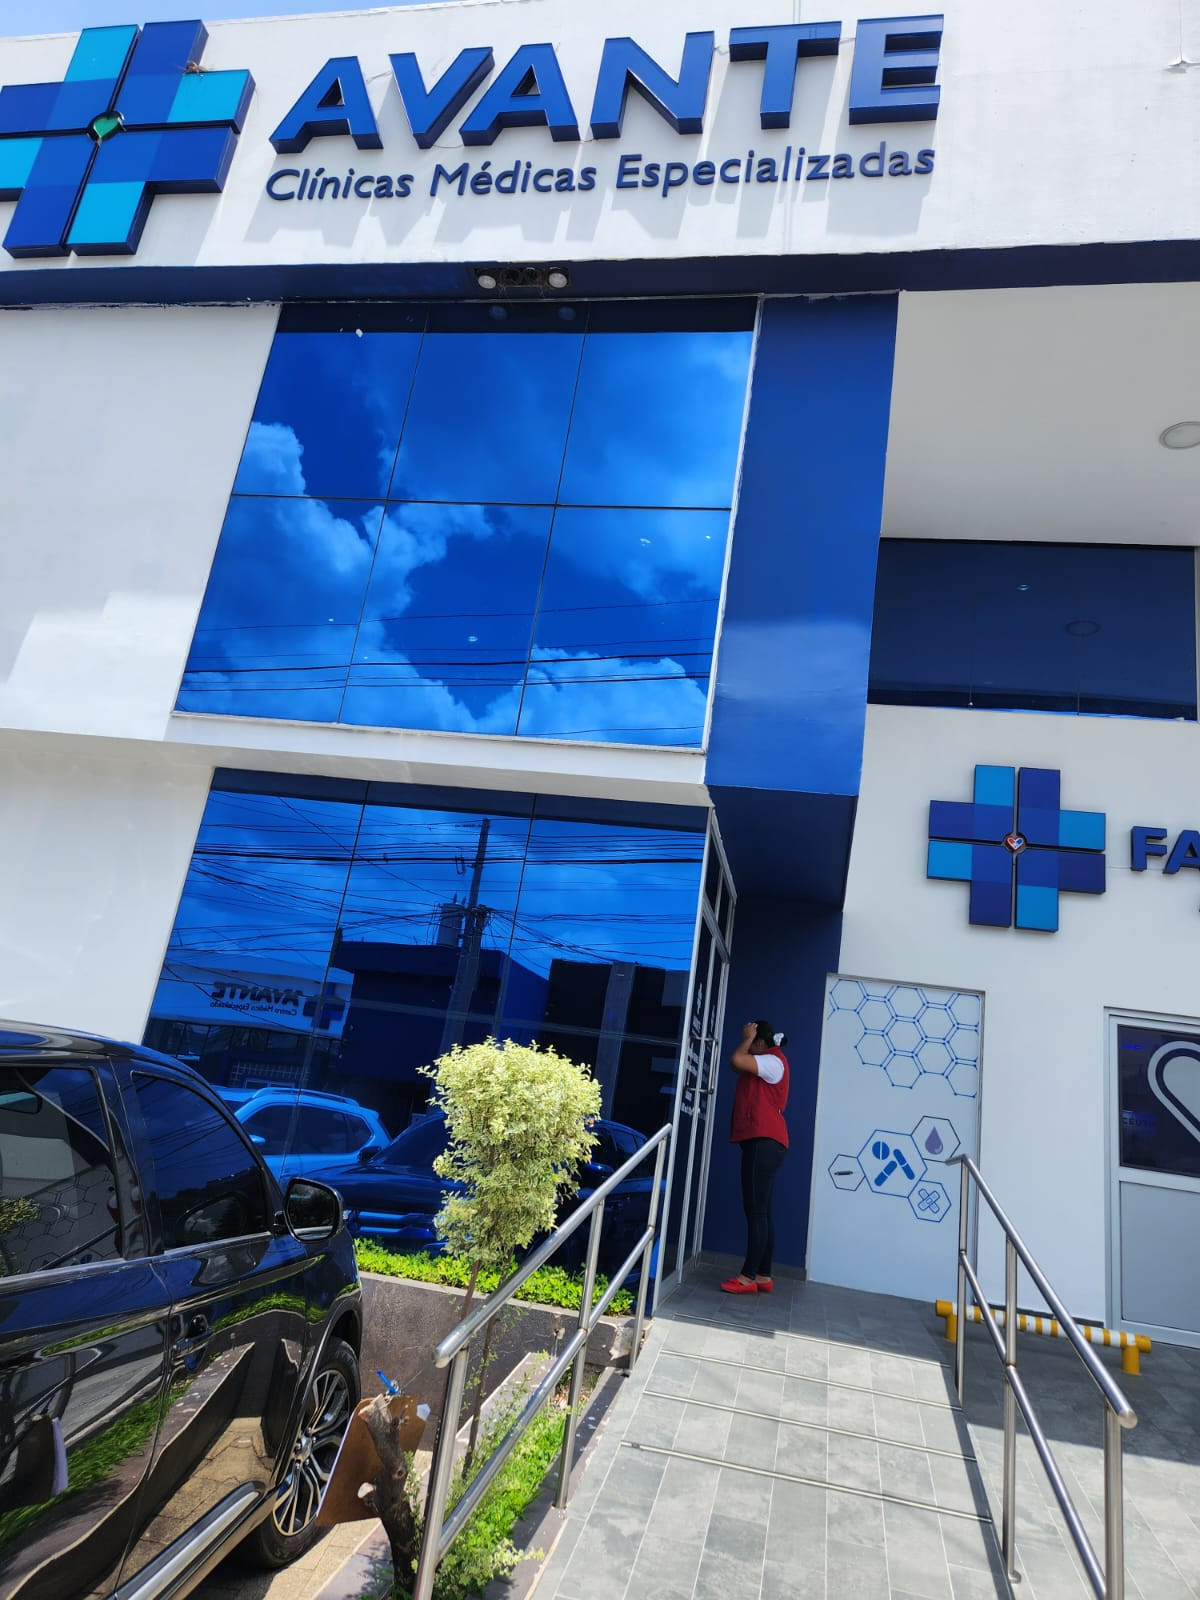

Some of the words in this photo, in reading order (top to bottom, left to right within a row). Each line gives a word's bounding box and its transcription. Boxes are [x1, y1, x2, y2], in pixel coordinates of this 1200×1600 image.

[268, 14, 944, 154] AVANTE
[266, 167, 414, 201] Clínicas
[429, 160, 597, 197] Médicas
[616, 141, 936, 198] Especializadas
